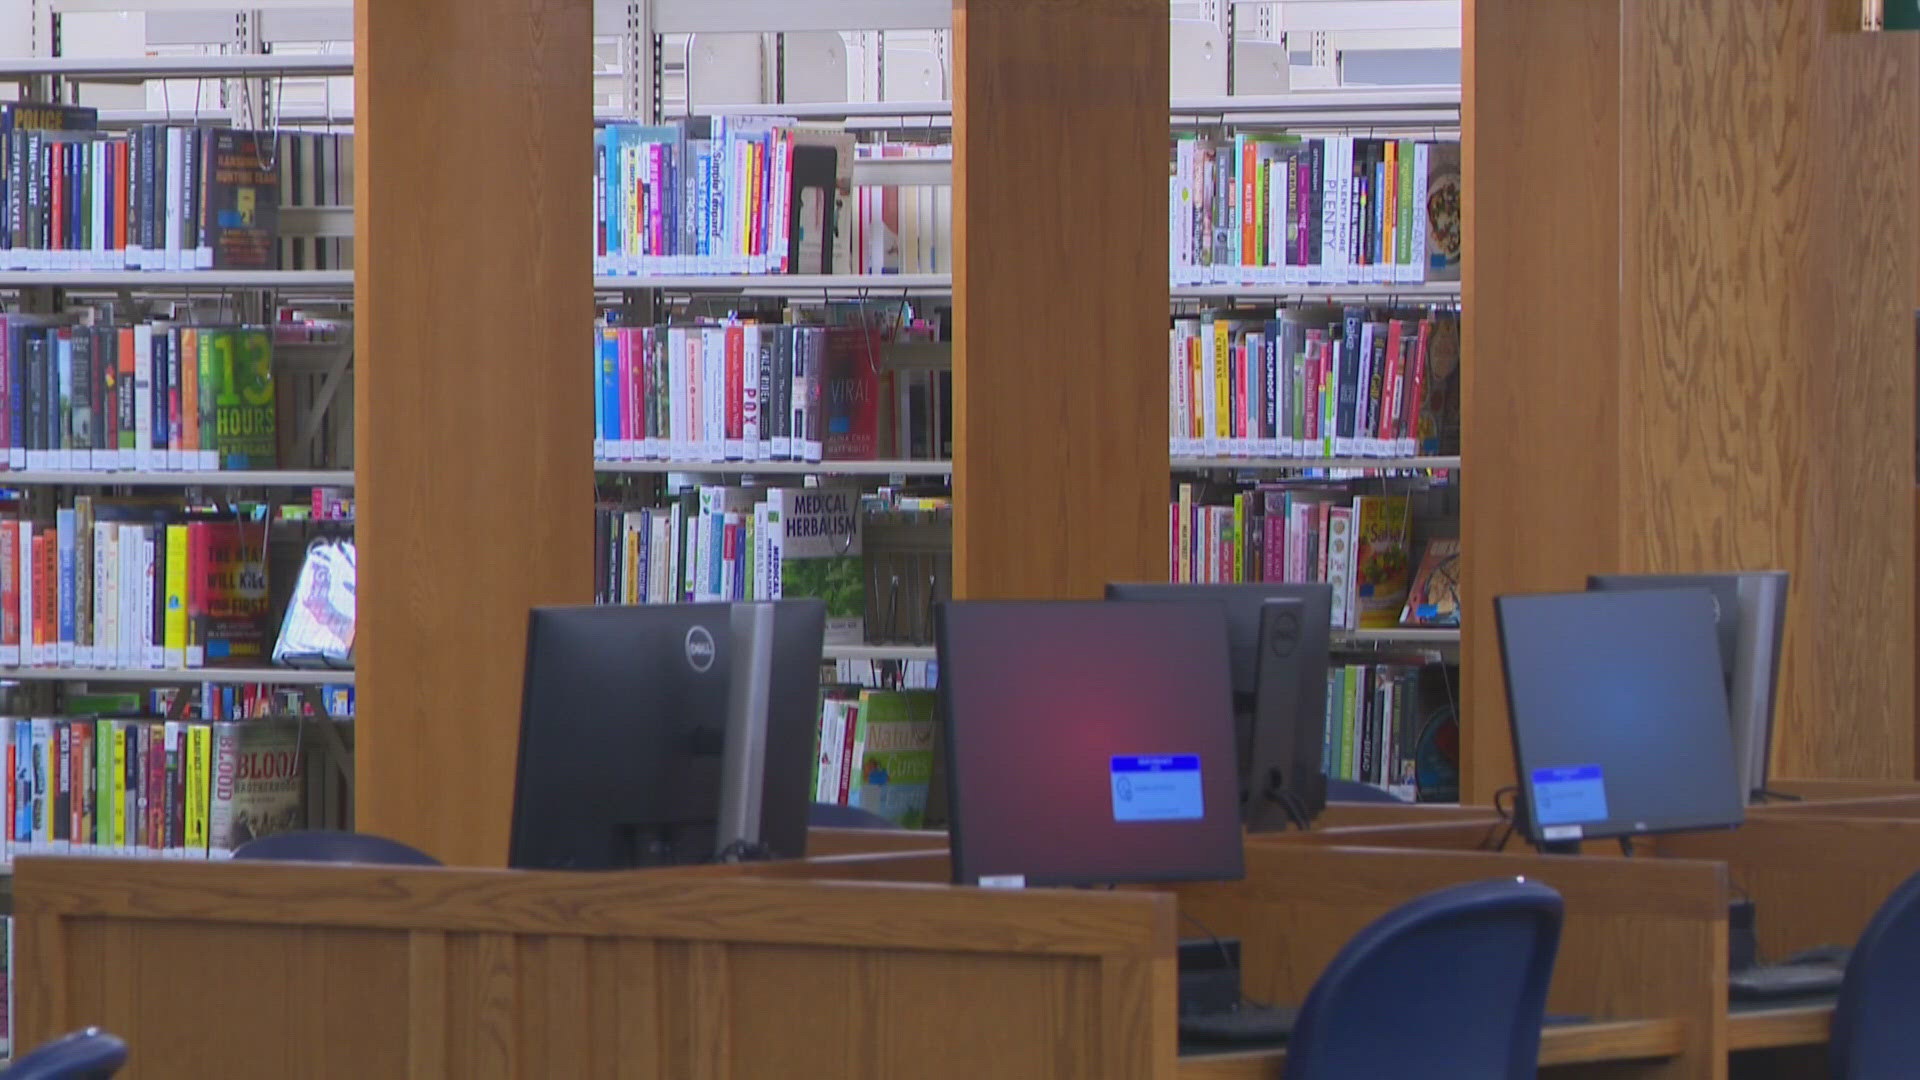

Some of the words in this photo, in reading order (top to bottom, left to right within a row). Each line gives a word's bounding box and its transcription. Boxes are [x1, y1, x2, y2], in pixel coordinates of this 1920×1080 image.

[29, 136, 38, 163] TRAIL
[711, 151, 723, 189] Supple
[1289, 155, 1297, 210] VEGETABLE
[686, 178, 696, 233] STRONG
[711, 191, 721, 237] Leopard
[1324, 179, 1337, 250] PLENTY
[1340, 178, 1348, 218] PLENTY
[1339, 222, 1347, 254] MORE
[214, 334, 275, 407] 13
[1266, 341, 1274, 399] FOOLPROOF
[744, 388, 757, 426] POX
[831, 379, 870, 403] VIRAL
[218, 408, 274, 437] HOURS
[795, 494, 849, 517] MEDICAL
[786, 517, 856, 538] HERBALISM
[218, 736, 233, 801] BLOOD
[236, 751, 301, 780] BLOOD
